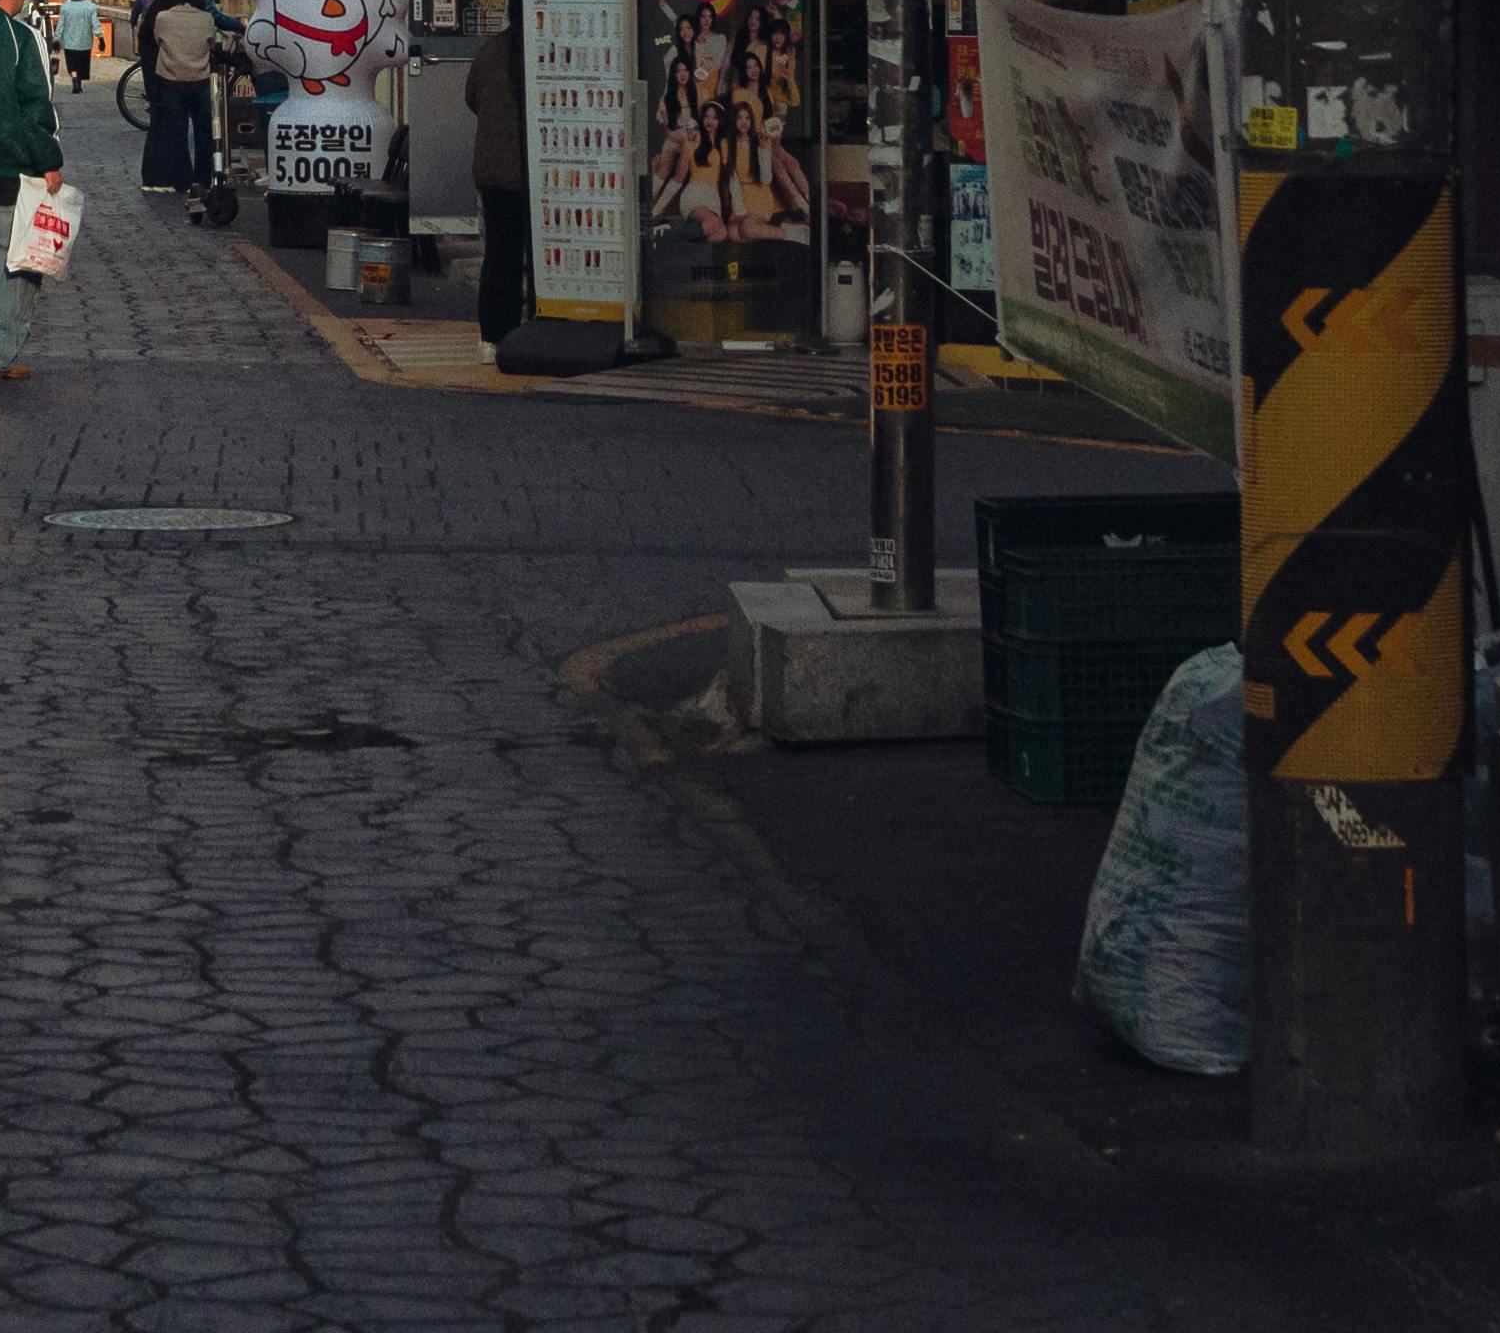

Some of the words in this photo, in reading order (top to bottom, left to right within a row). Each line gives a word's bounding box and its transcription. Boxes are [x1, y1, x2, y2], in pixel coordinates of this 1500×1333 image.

[275, 123, 372, 152] 포장할인
[874, 363, 923, 384] 1588
[874, 385, 923, 406] 6195
